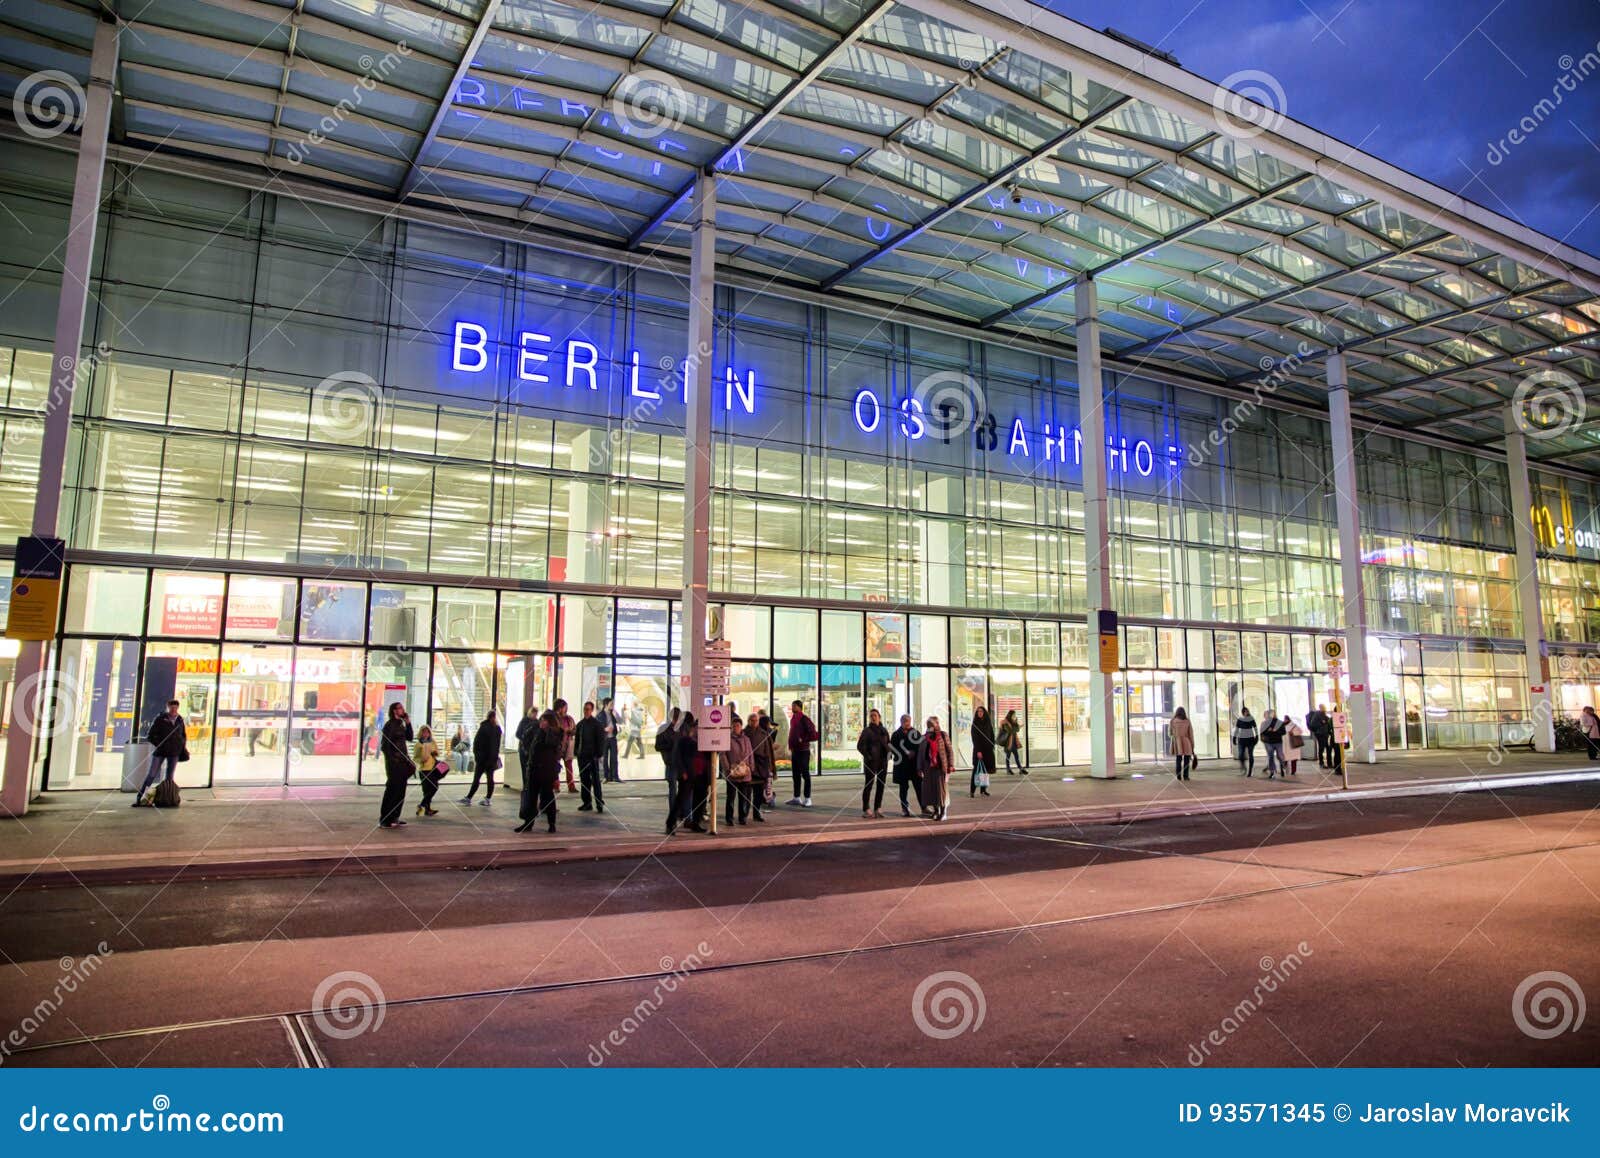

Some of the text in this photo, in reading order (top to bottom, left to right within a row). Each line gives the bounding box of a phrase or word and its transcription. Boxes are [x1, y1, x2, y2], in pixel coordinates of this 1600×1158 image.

[452, 322, 756, 413] BERLIN
[167, 597, 218, 613] REWE
[176, 658, 239, 674] UNKIN'
